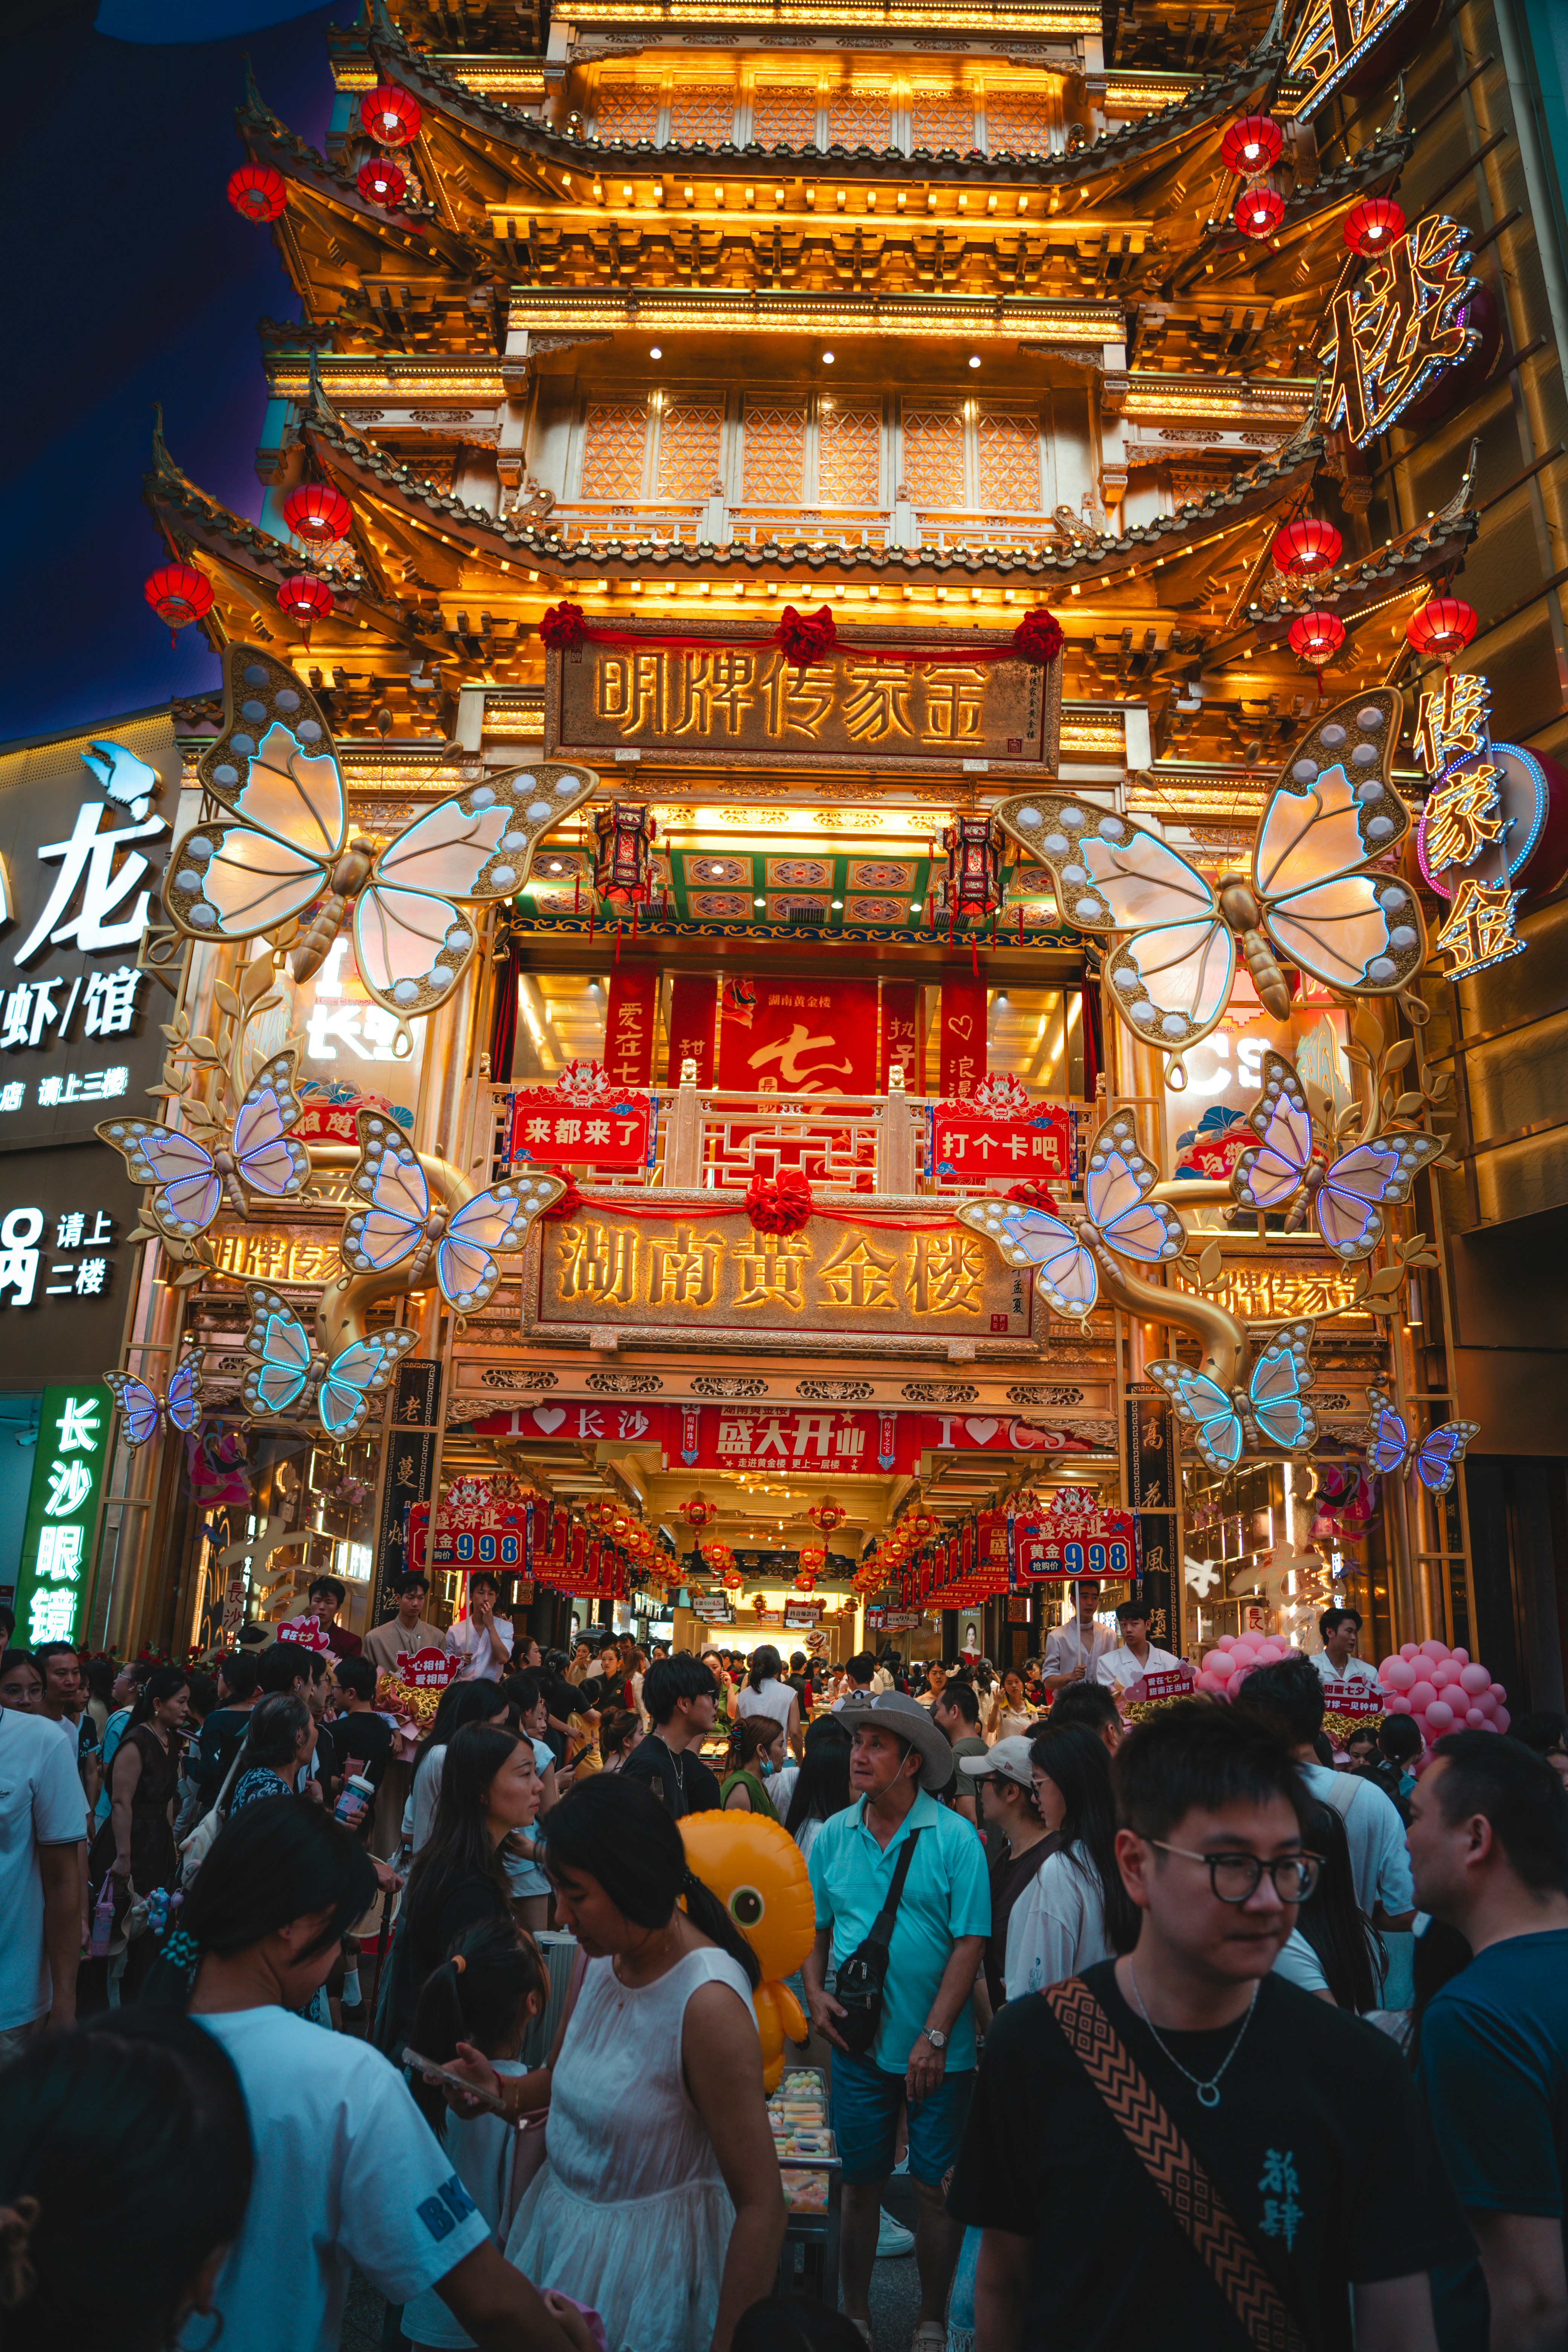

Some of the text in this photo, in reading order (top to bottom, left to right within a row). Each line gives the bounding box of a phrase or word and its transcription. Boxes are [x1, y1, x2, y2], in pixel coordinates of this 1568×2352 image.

[599, 650, 986, 743] 明牌传家金
[1413, 674, 1519, 978] 传家金
[0, 801, 167, 967] 龙
[768, 994, 831, 1008] 湖南黄金楼
[613, 1003, 643, 1084] 爱在七
[38, 1067, 129, 1106] 请上三楼
[524, 1117, 640, 1146] 来都来了
[942, 1132, 1058, 1161] 打个卡吧
[57, 1211, 112, 1248] 请上
[46, 1259, 106, 1295] 二楼
[560, 1223, 985, 1313] 湖南黄金楼
[574, 1408, 649, 1440] 长沙
[723, 1405, 789, 1416] 湖南黄金楼
[686, 1416, 695, 1449] 明牌珠宝
[716, 1415, 866, 1456] 盛大开业
[937, 1417, 956, 1448] I
[738, 1458, 840, 1470] 走进黄金楼 更上一层楼
[28, 1397, 101, 1645] 长沙眼镜
[436, 1508, 503, 1531] 盛大开业
[1038, 1516, 1110, 1540] 盛大开业
[456, 1533, 518, 1563] 998
[1030, 1542, 1128, 1574] 黄金 998
[1032, 1561, 1059, 1571] 抢购价
[223, 1582, 243, 1630] 長沙
[281, 1629, 314, 1642] 爱在七夕
[414, 1660, 446, 1671] 心相惜
[415, 1674, 449, 1685] 爱相随
[1148, 1674, 1180, 1686] 爱在七夕
[1149, 1682, 1190, 1696] 甜蜜正当时
[1324, 1684, 1365, 1695] 甜蜜七夕
[416, 2174, 476, 2242] BK
